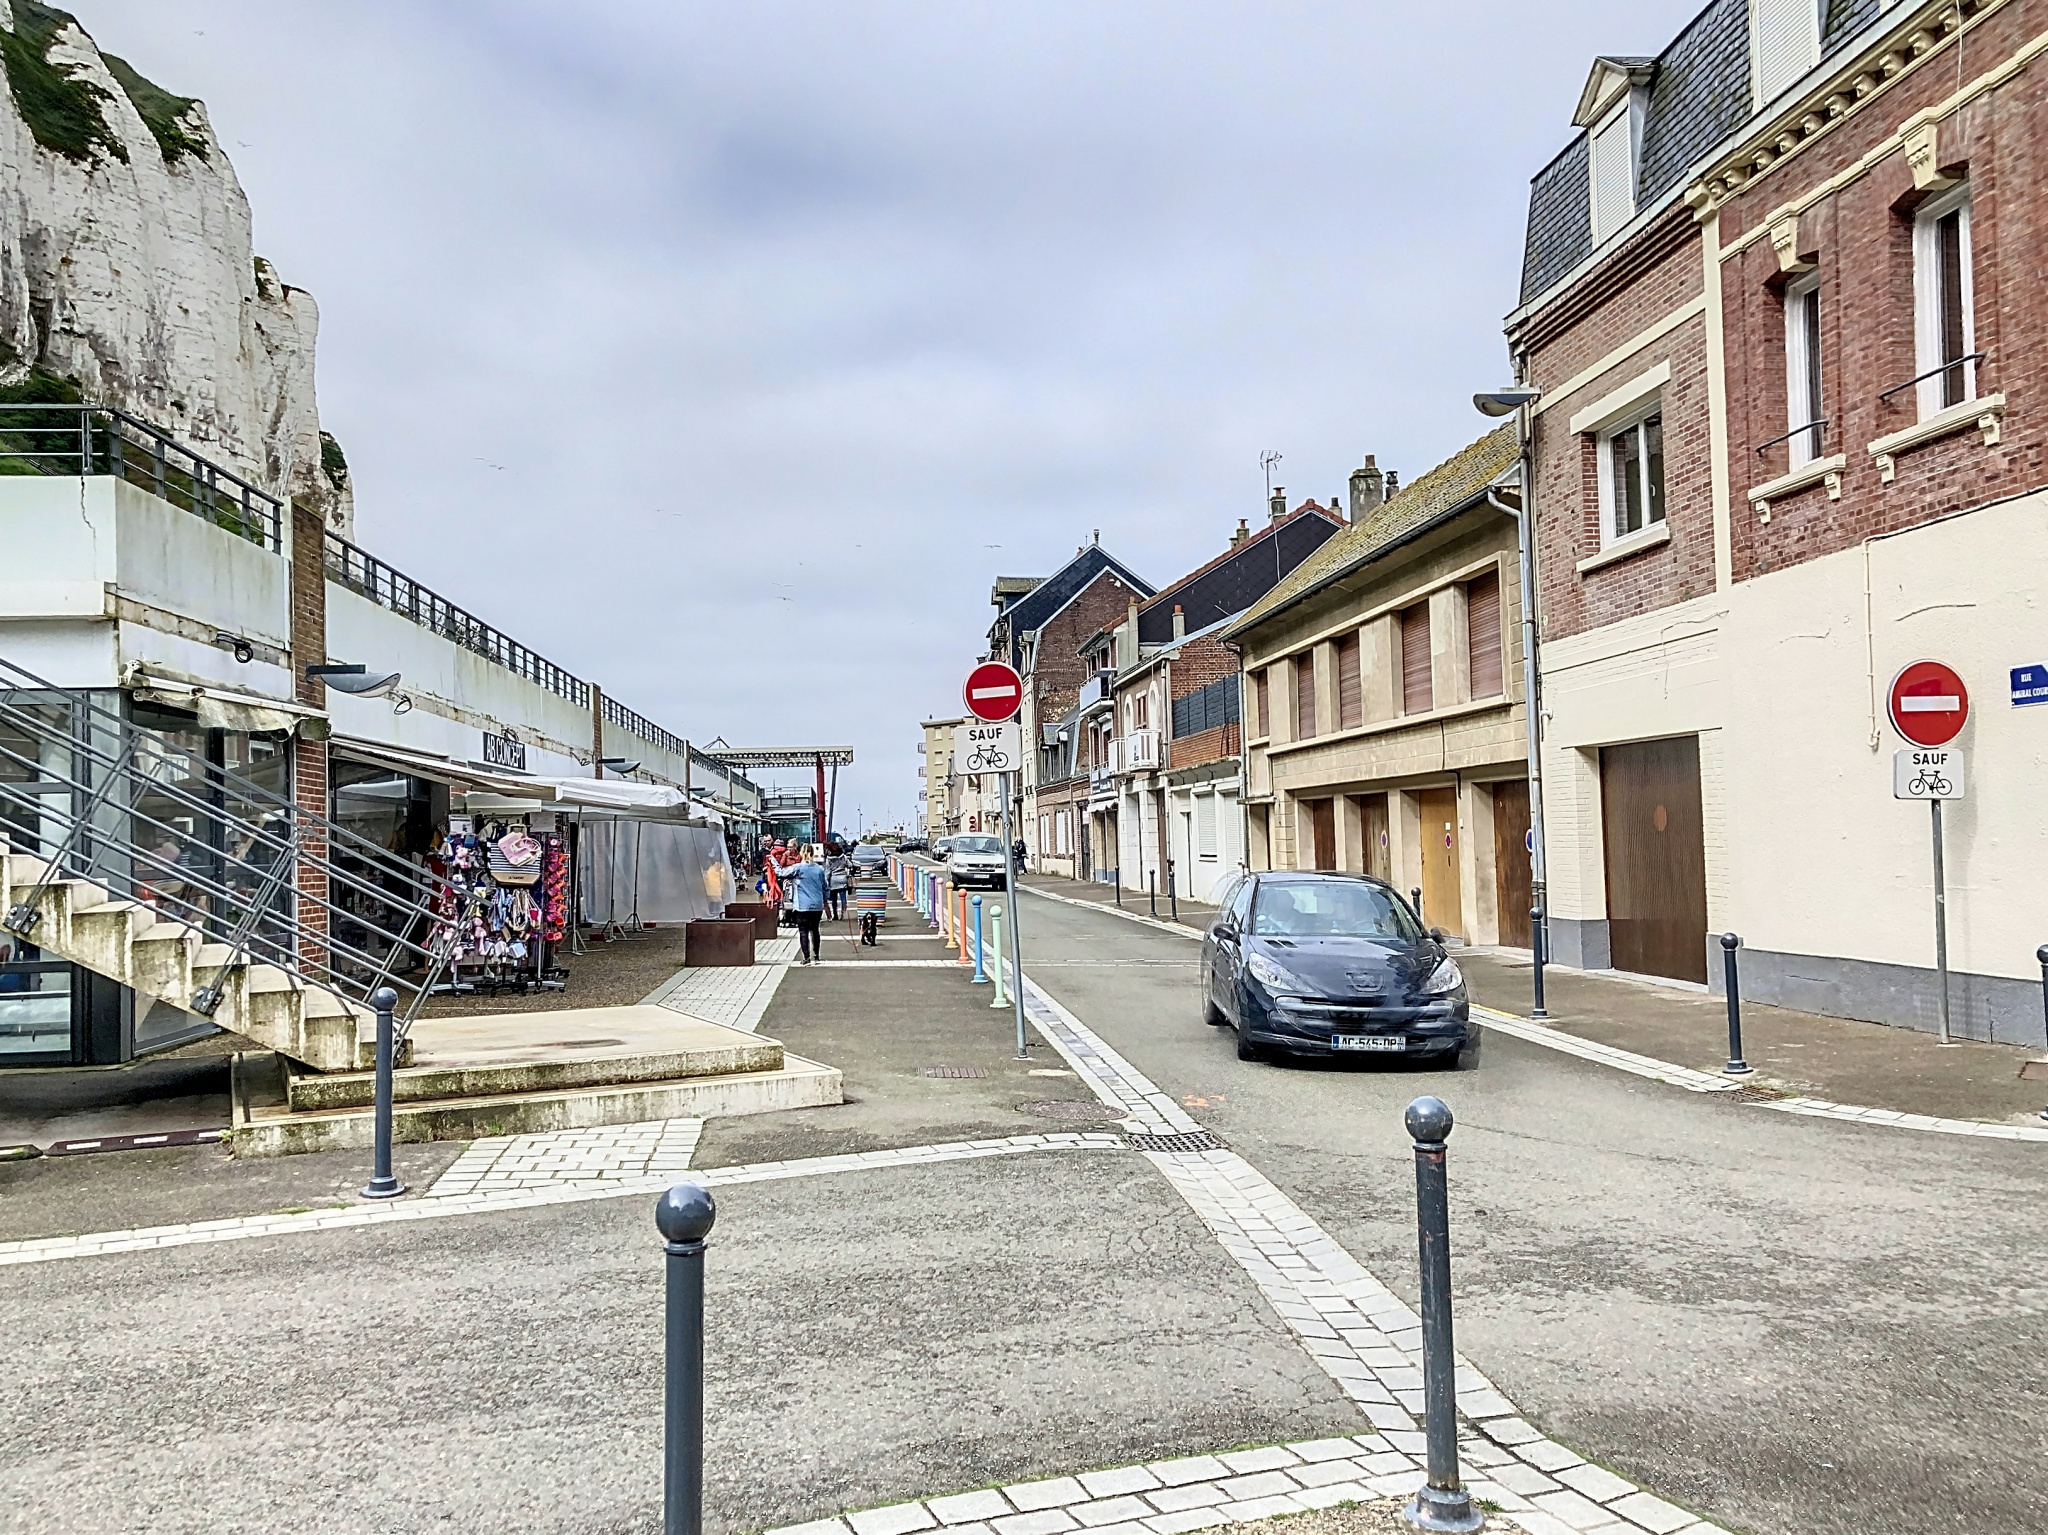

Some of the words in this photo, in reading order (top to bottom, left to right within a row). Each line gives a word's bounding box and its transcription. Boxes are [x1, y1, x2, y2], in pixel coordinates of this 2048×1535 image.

[2021, 673, 2032, 682] RUE
[969, 728, 1002, 740] SAUF
[487, 733, 496, 762] AB
[496, 736, 523, 769] CONCEPT
[1913, 753, 1948, 765] SAUF
